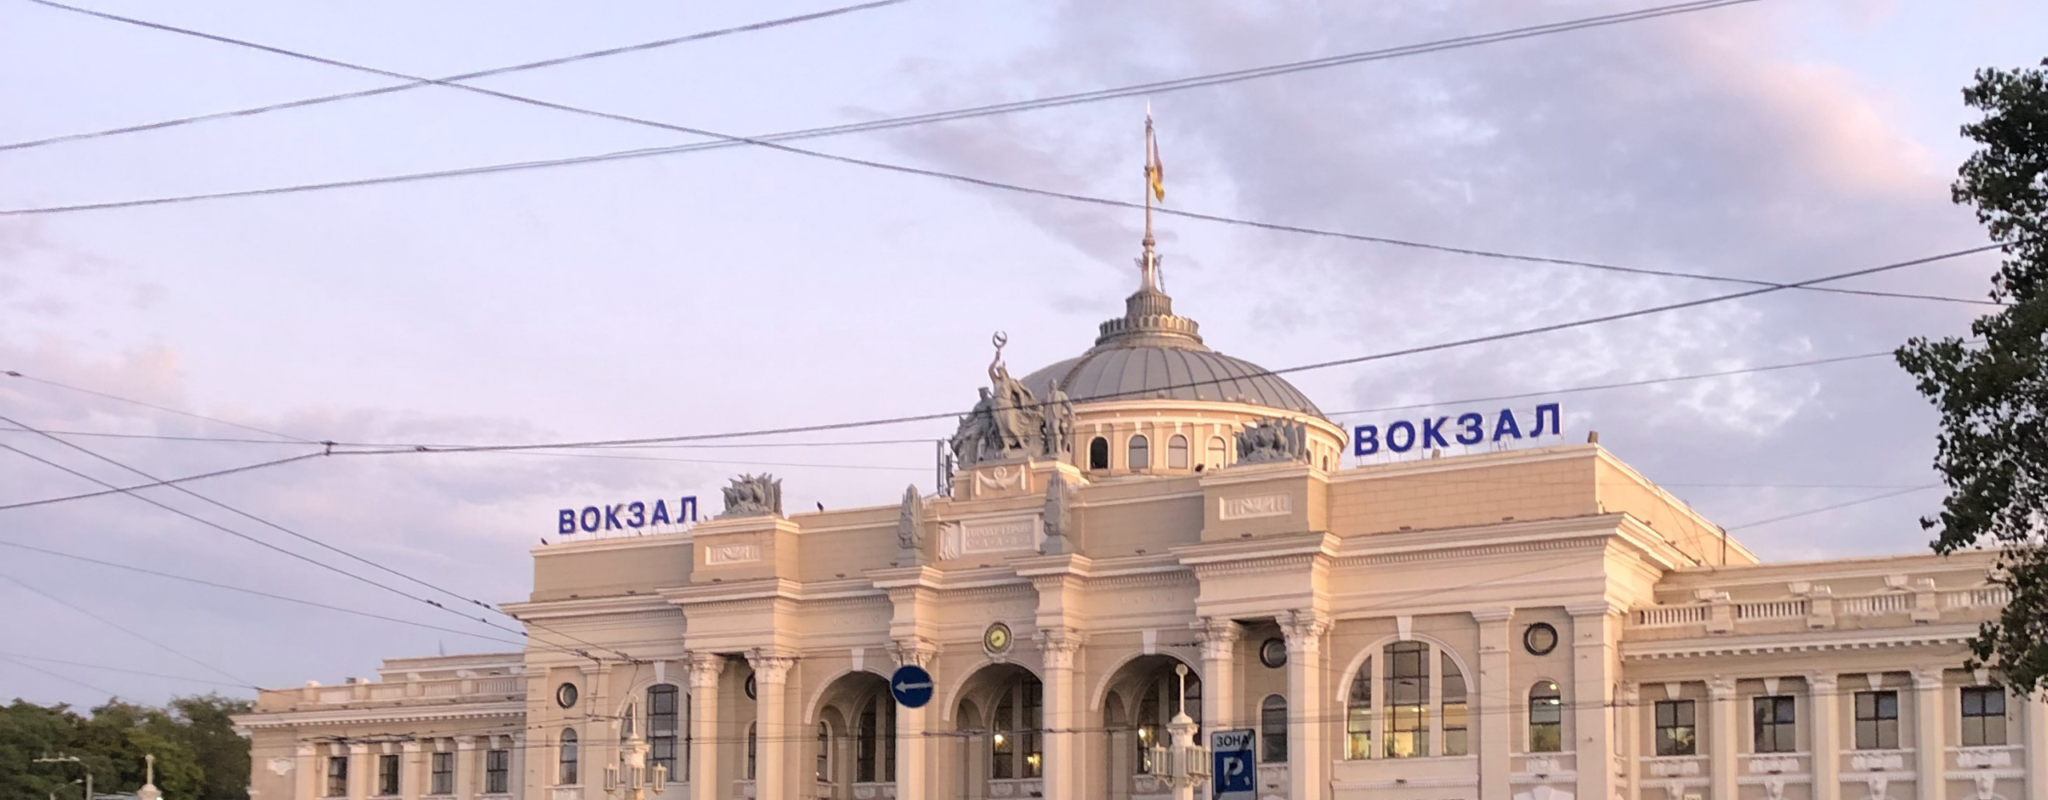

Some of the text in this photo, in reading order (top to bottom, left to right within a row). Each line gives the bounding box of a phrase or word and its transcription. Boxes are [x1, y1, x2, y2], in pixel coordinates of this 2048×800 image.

[1354, 402, 1561, 457] ВОКЗАЛ
[558, 495, 697, 535] ВОКЗАЛ
[1216, 734, 1250, 748] ЗОНА
